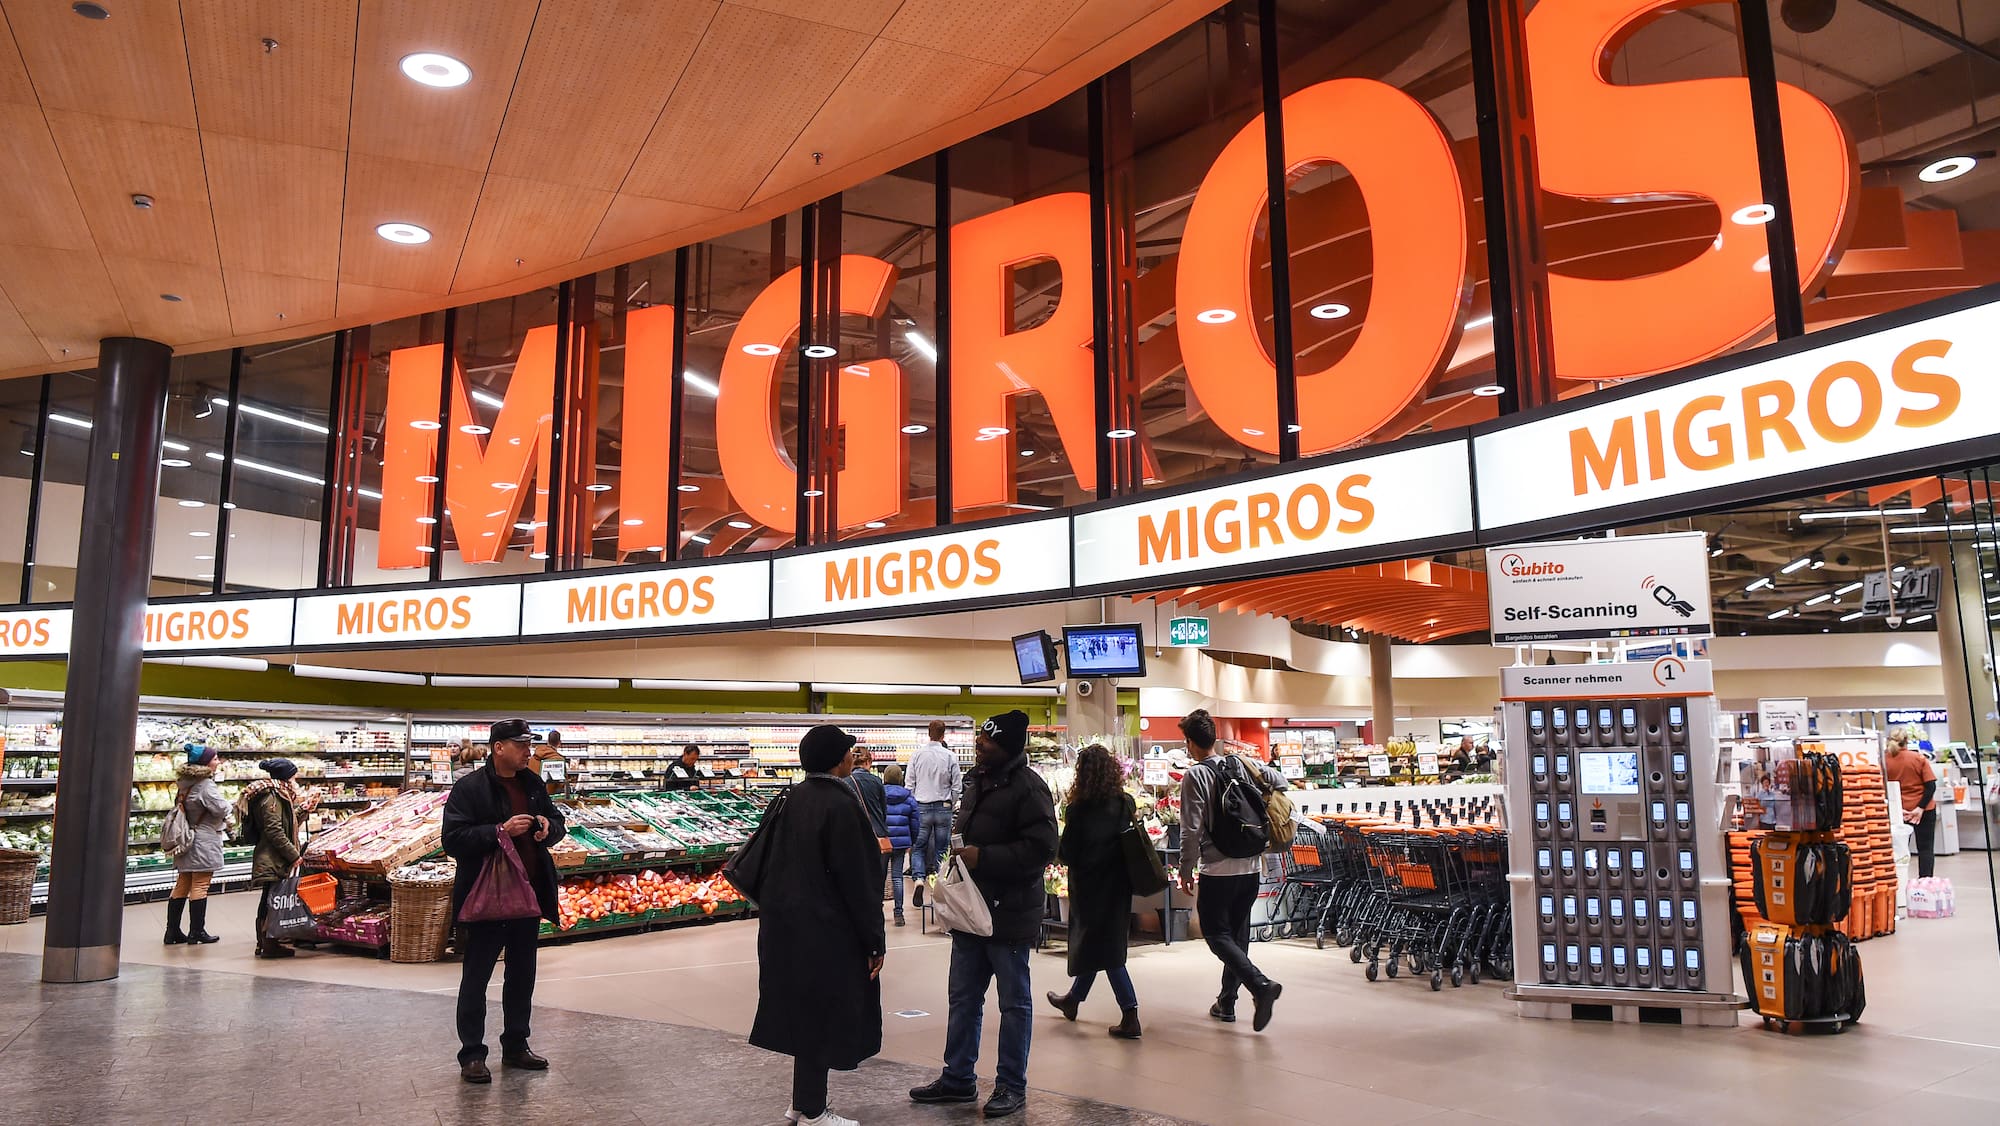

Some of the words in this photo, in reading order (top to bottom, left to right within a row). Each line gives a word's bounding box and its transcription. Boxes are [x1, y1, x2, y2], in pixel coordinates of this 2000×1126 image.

[377, 0, 1858, 570] MIGROS
[1568, 339, 1962, 497] MIGROS
[1137, 473, 1375, 566] MIGROS
[825, 538, 1002, 603] MIGROS
[1511, 562, 1564, 577] subito
[337, 595, 471, 635] MIGROS
[567, 575, 715, 624] MIGROS
[1504, 602, 1638, 621] Self-Scanning
[1523, 675, 1571, 686] Scanner
[1575, 674, 1623, 685] nehmen
[1664, 664, 1676, 681] 1
